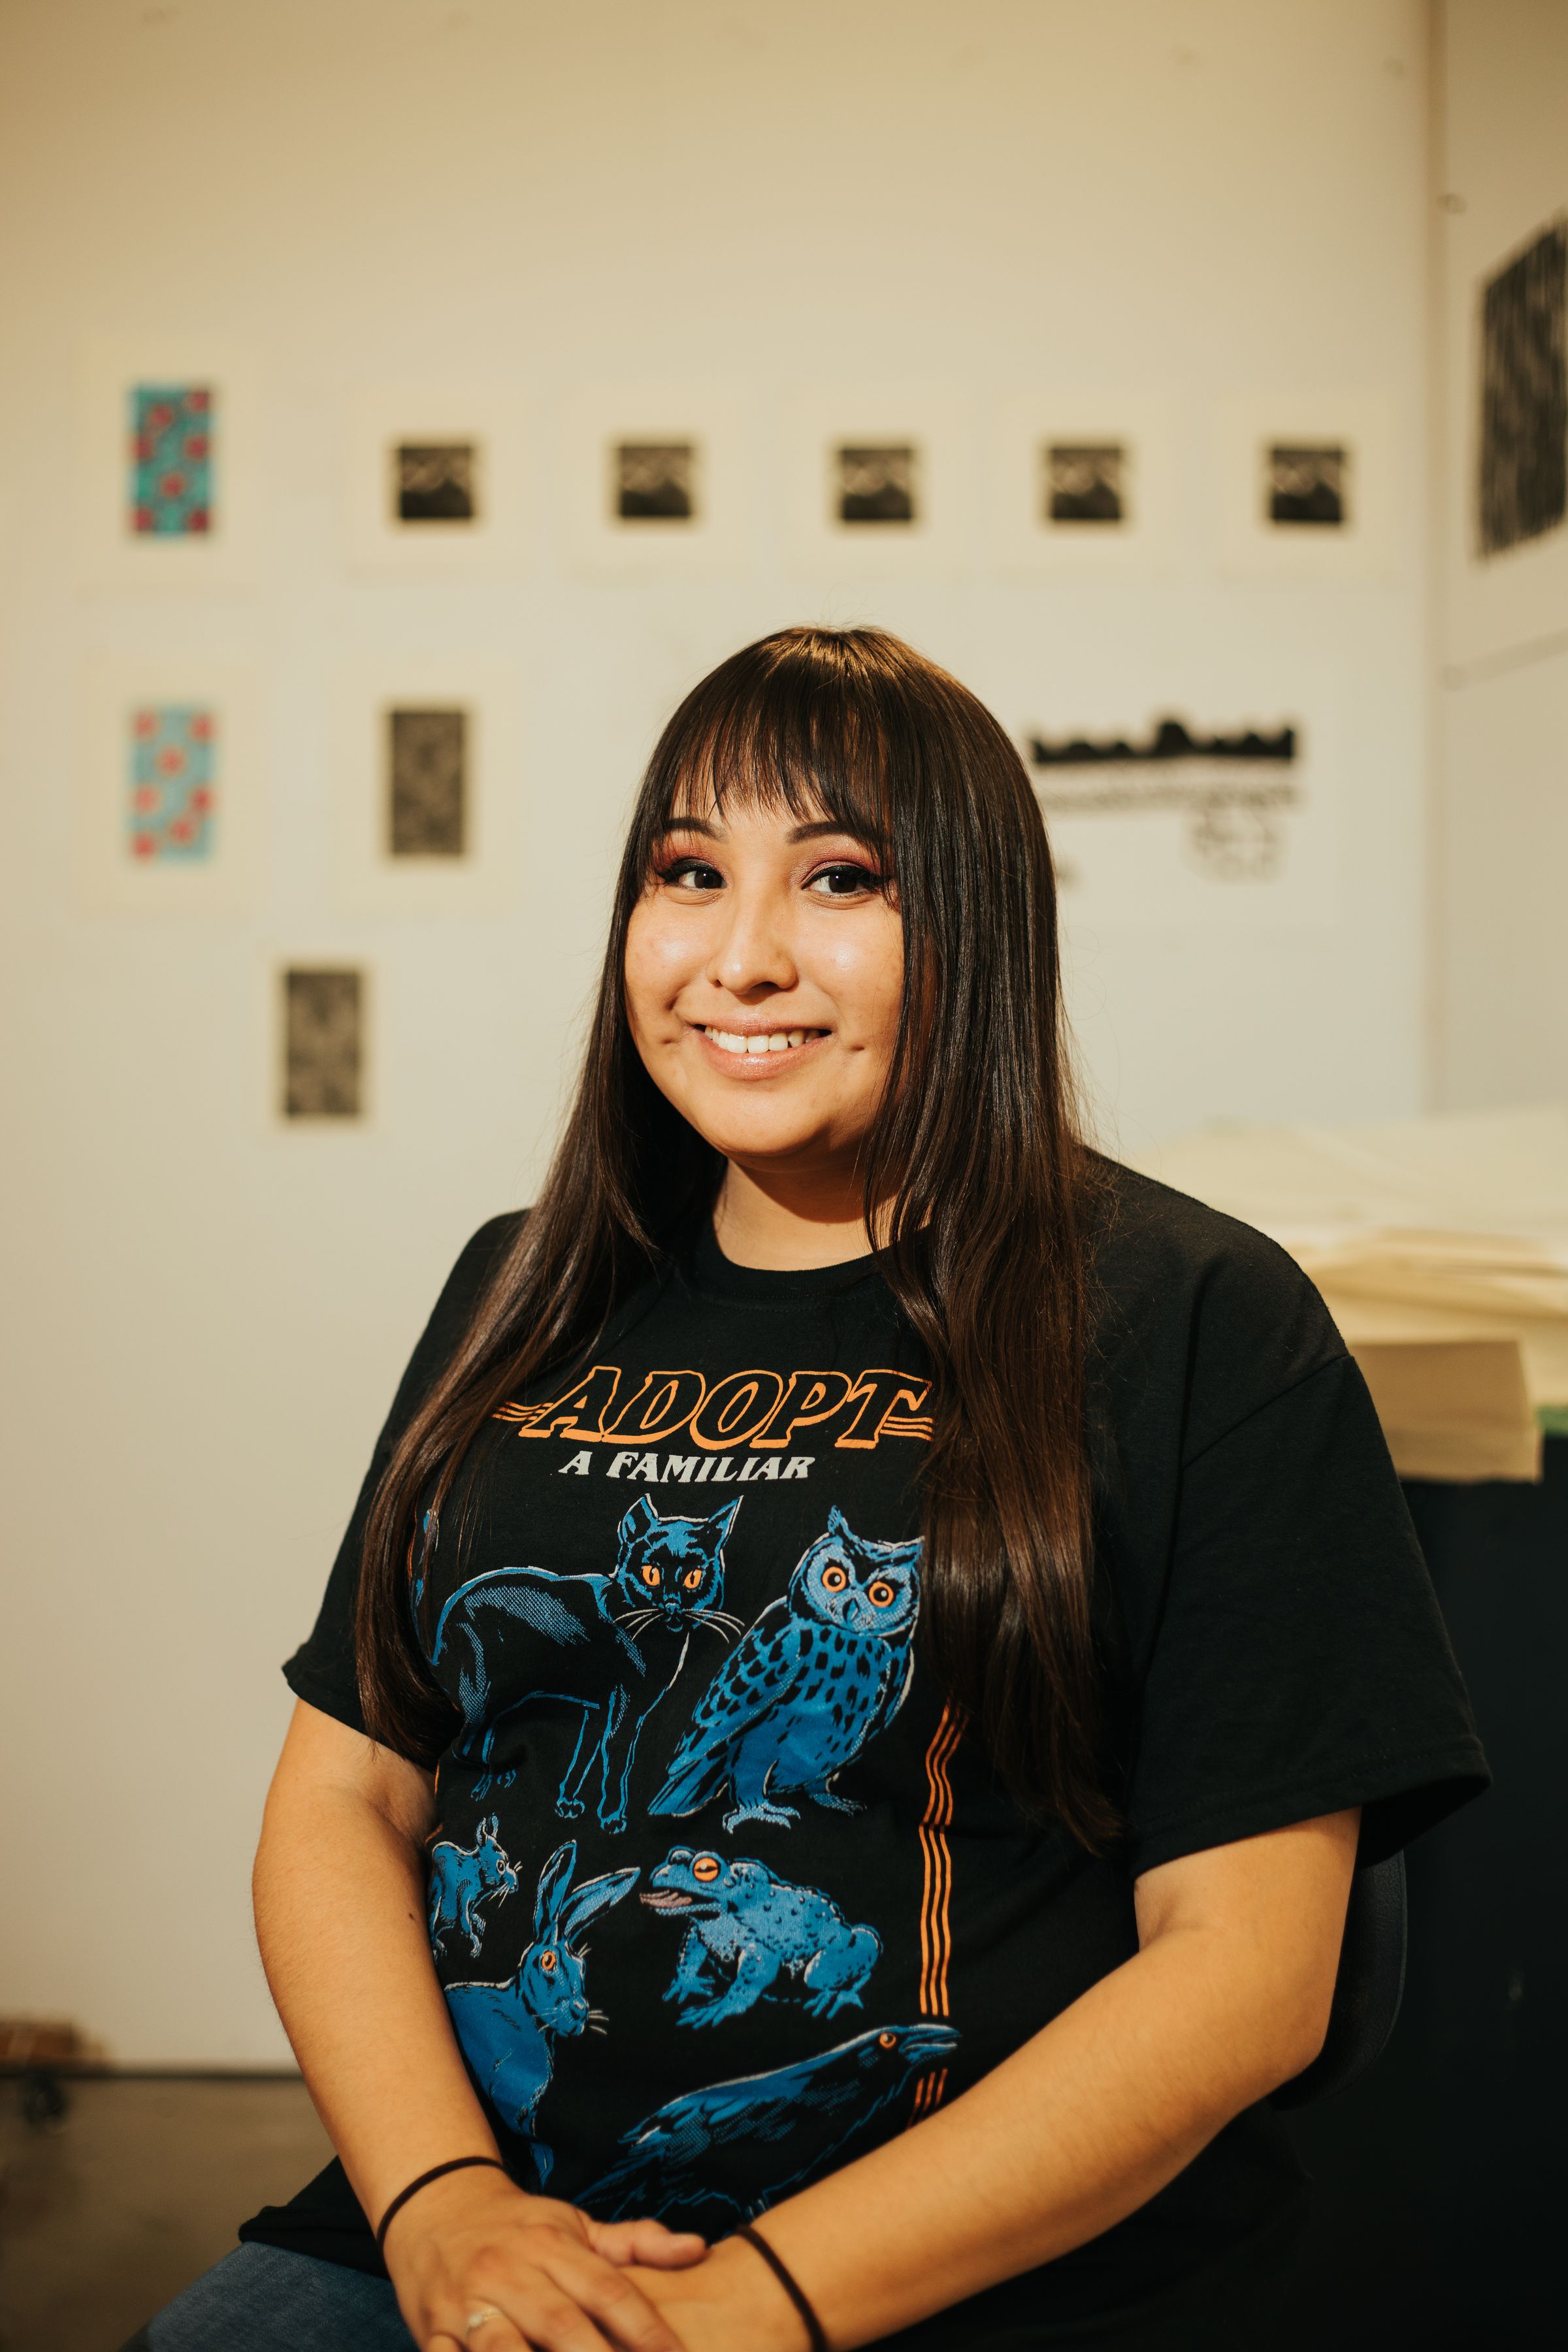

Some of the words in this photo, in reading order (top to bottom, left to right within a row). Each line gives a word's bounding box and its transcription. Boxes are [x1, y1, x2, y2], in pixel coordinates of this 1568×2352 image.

[519, 1365, 933, 1450] ADOPT
[559, 1450, 592, 1475] A
[606, 1451, 815, 1482] FAMILIAR
